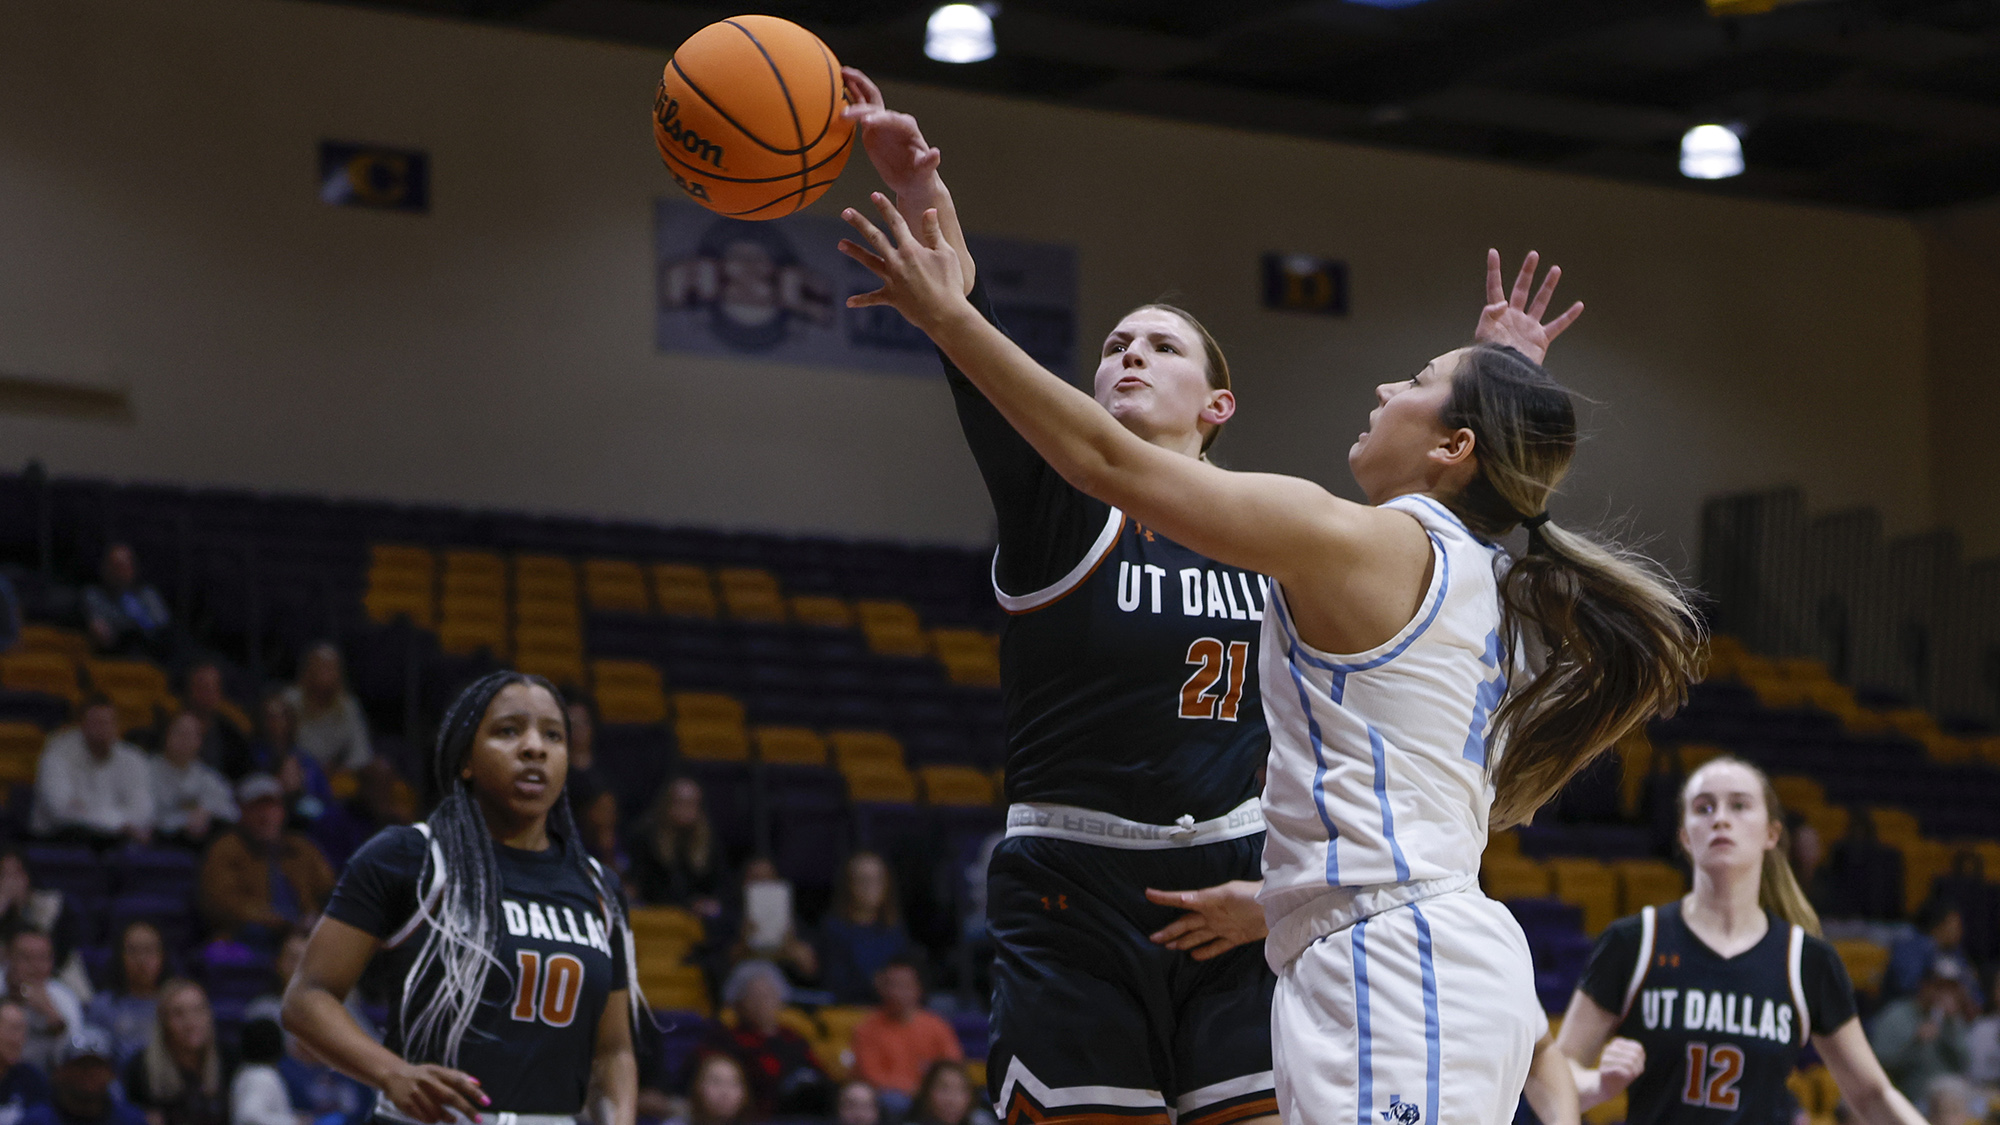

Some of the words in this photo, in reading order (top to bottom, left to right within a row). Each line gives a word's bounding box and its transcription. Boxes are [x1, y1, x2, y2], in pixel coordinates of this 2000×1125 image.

[1117, 560, 1166, 616] UT
[1179, 567, 1267, 621] DALL
[1177, 636, 1249, 722] 21
[511, 949, 584, 1028] 10
[1642, 988, 1678, 1030] UT
[1683, 988, 1792, 1045] DALLAS
[1682, 1041, 1745, 1112] 12
